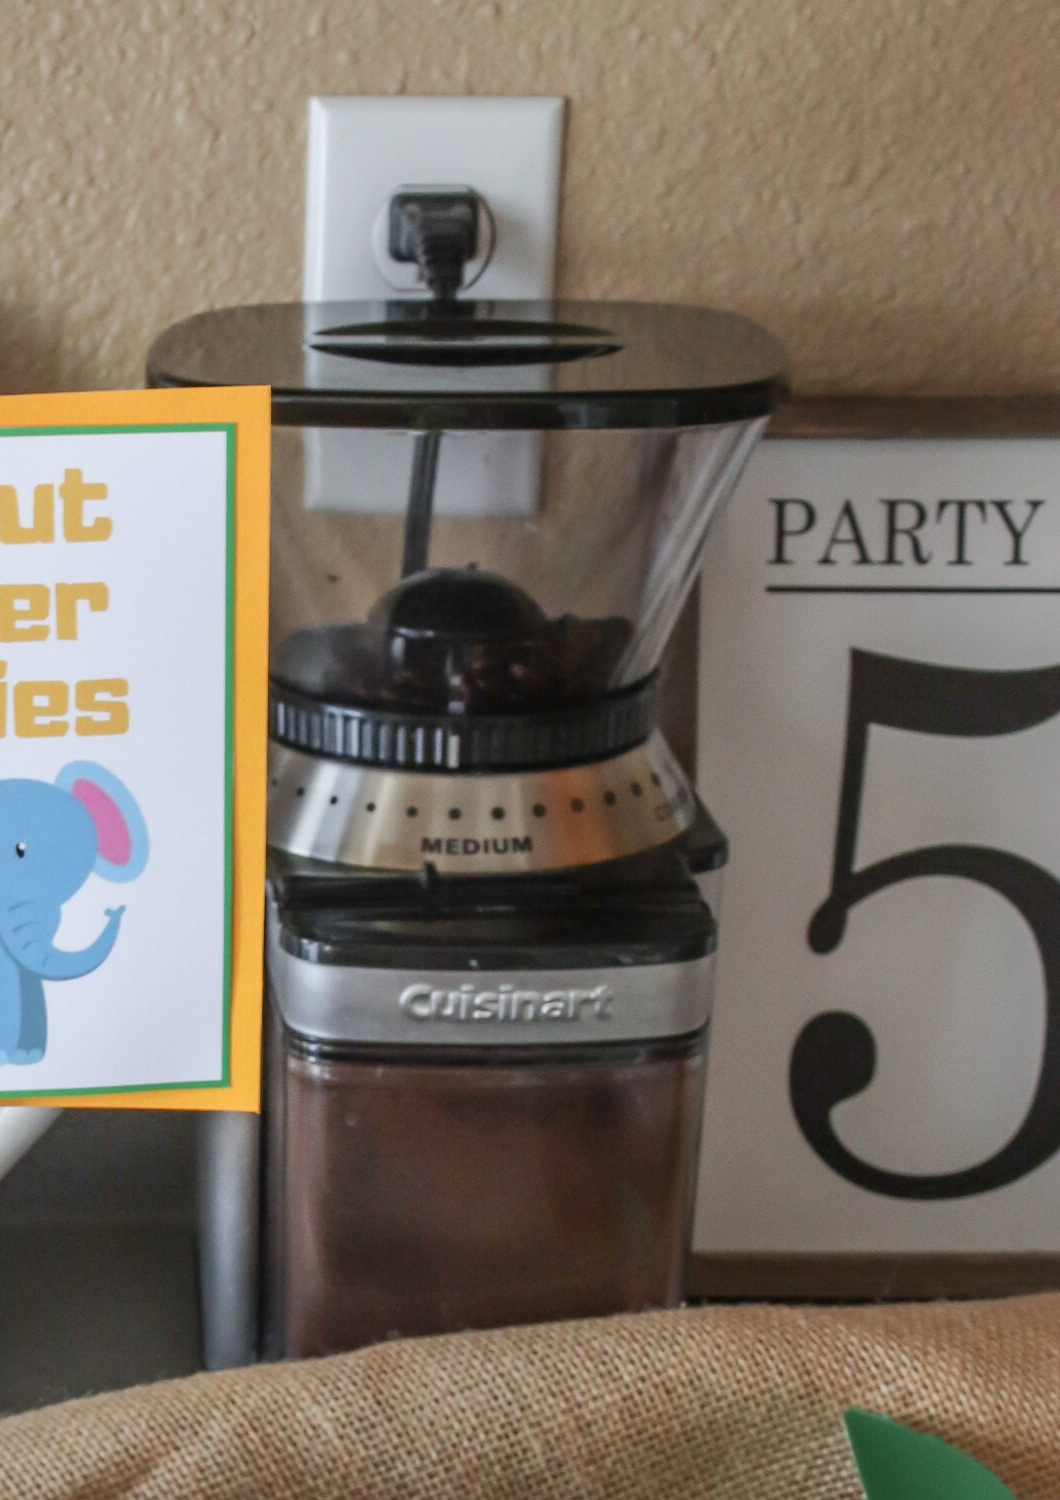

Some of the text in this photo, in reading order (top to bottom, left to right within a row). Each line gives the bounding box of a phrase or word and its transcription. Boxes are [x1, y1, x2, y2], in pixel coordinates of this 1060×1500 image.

[766, 498, 1044, 565] PARTY
[421, 836, 533, 856] MEDIUM
[788, 646, 1060, 1200] 5
[399, 983, 613, 1021] Cuisinart
